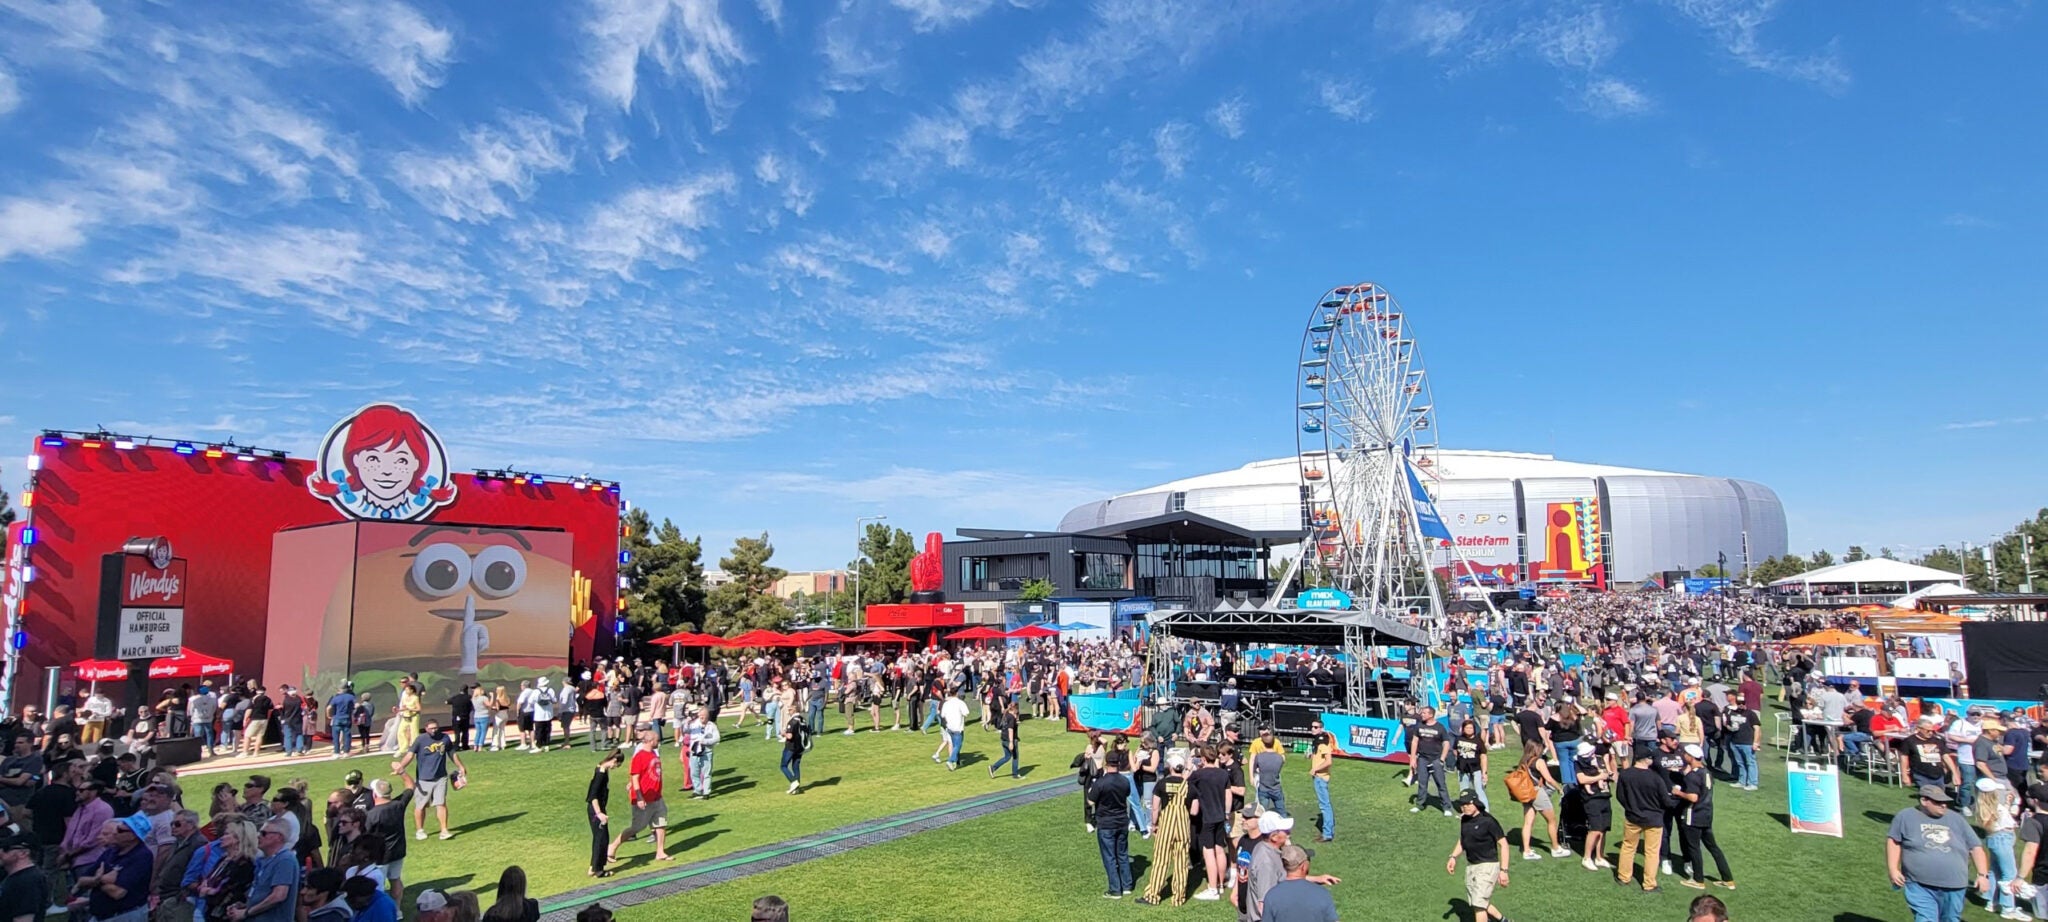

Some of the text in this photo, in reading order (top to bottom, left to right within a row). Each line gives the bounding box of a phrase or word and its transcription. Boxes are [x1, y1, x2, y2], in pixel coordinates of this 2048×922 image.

[130, 569, 179, 600] Wendy's
[136, 611, 166, 621] OFFICIAL
[129, 622, 170, 633] HAMBURGER
[144, 634, 153, 644] OF
[122, 644, 179, 657] MARCH MADNESS
[1358, 727, 1388, 738] TIP-OFF
[1352, 735, 1386, 747] TAILGATE
